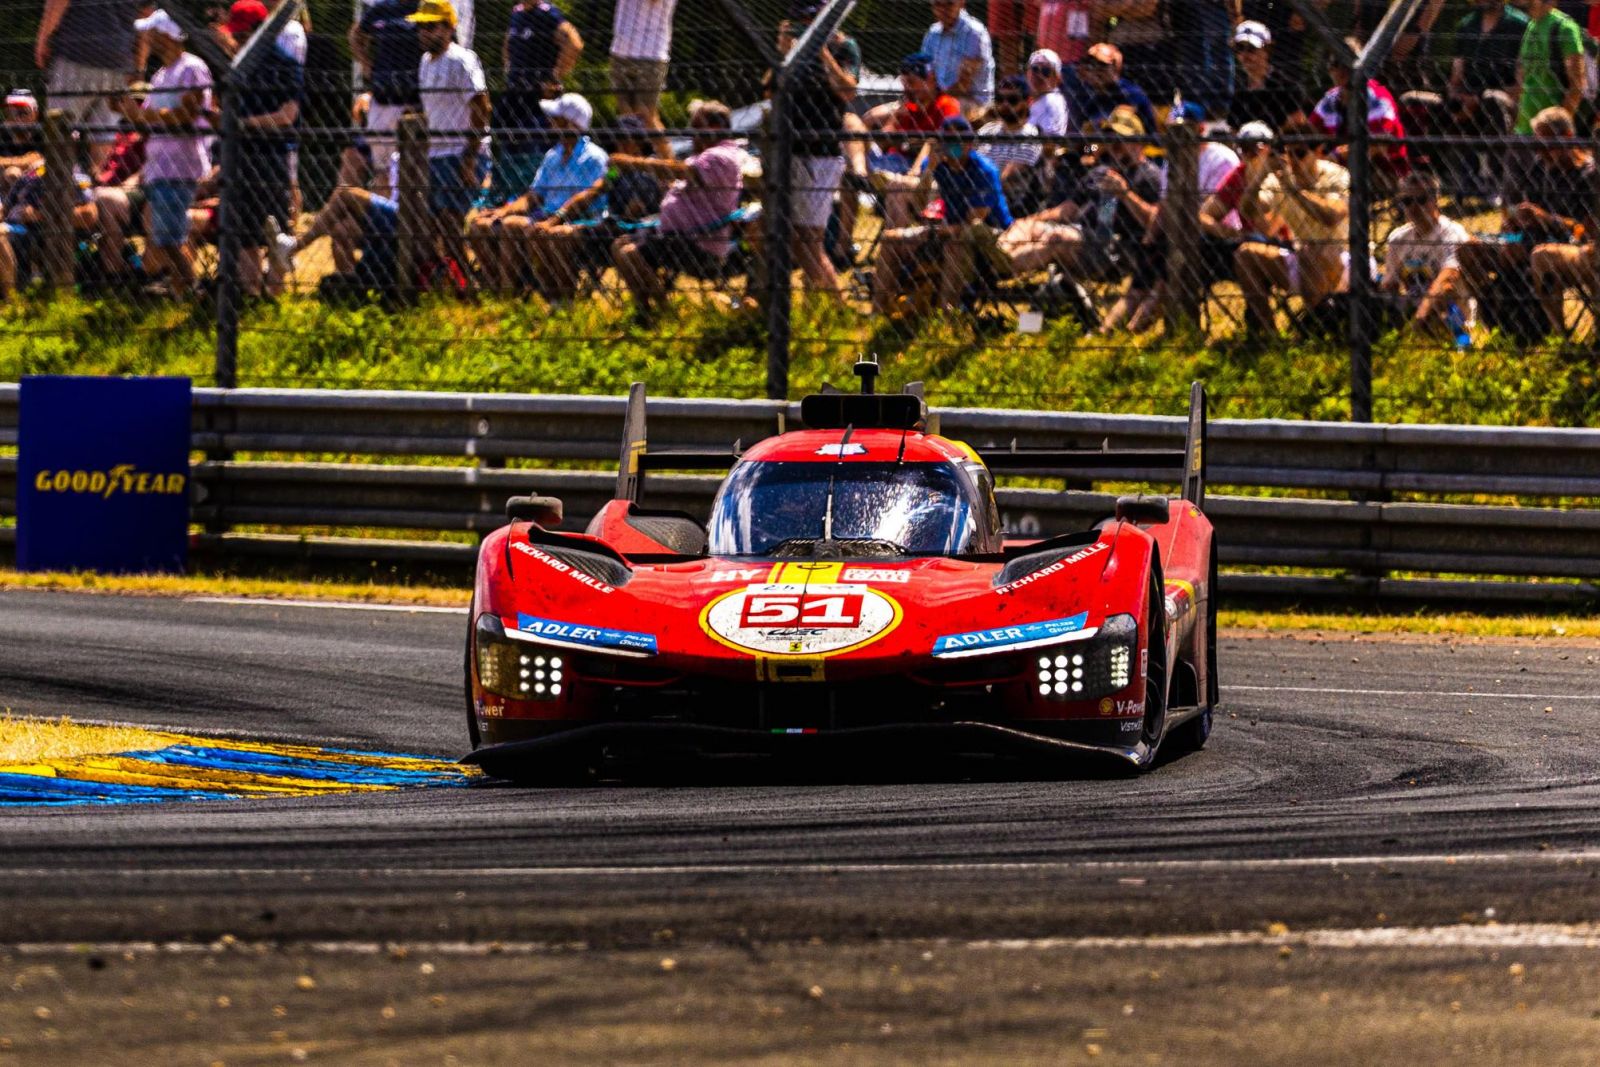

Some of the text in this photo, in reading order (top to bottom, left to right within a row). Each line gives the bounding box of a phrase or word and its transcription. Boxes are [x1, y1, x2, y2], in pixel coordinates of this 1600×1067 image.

[1064, 541, 1110, 565] MILLE
[511, 541, 616, 594] RICHARD MILLE
[746, 597, 855, 624] 51
[522, 621, 602, 641] ADLER
[944, 628, 1024, 648] ADLER
